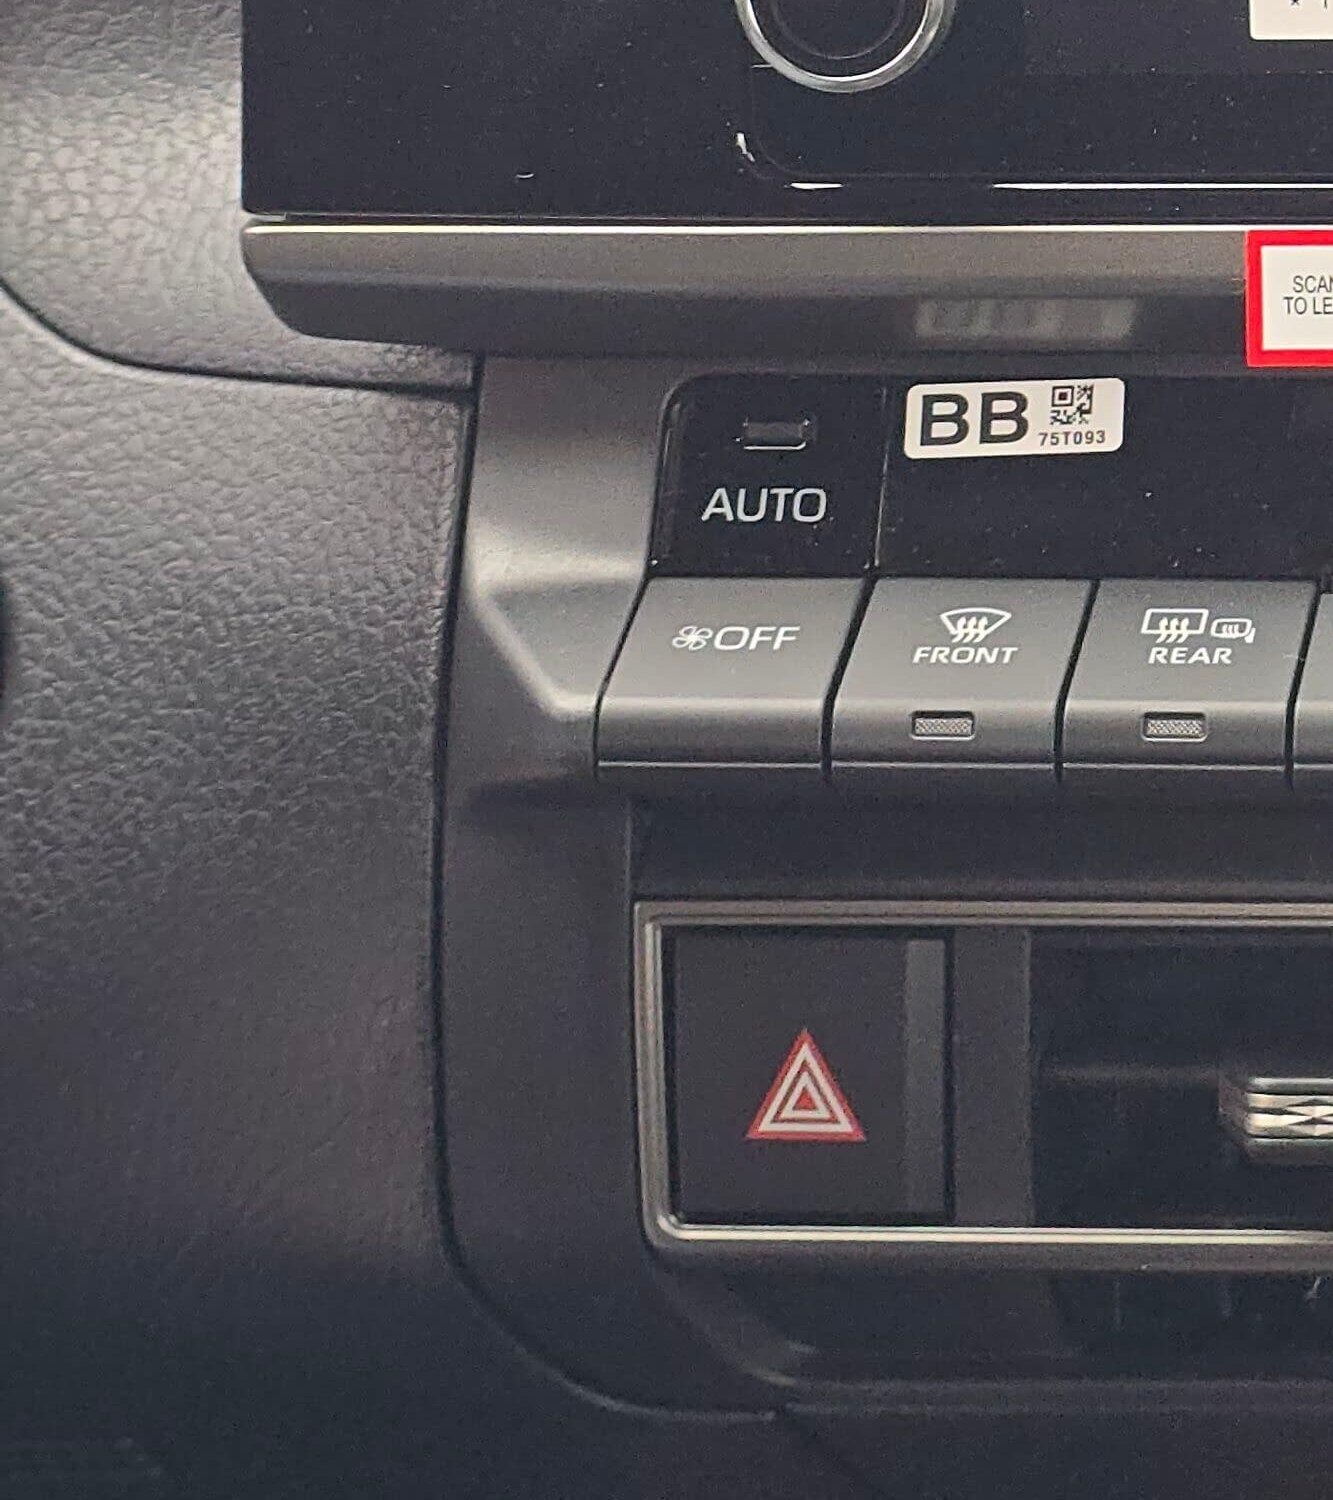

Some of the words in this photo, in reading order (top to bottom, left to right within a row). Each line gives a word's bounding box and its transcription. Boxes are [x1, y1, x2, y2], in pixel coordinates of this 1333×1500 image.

[1282, 296, 1308, 316] TO
[919, 390, 1029, 447] BB
[1037, 429, 1106, 447] 75T093
[700, 487, 827, 523] AUTO
[713, 625, 801, 651] OFF
[911, 646, 1019, 664] FRONT
[1147, 646, 1233, 665] REAR
